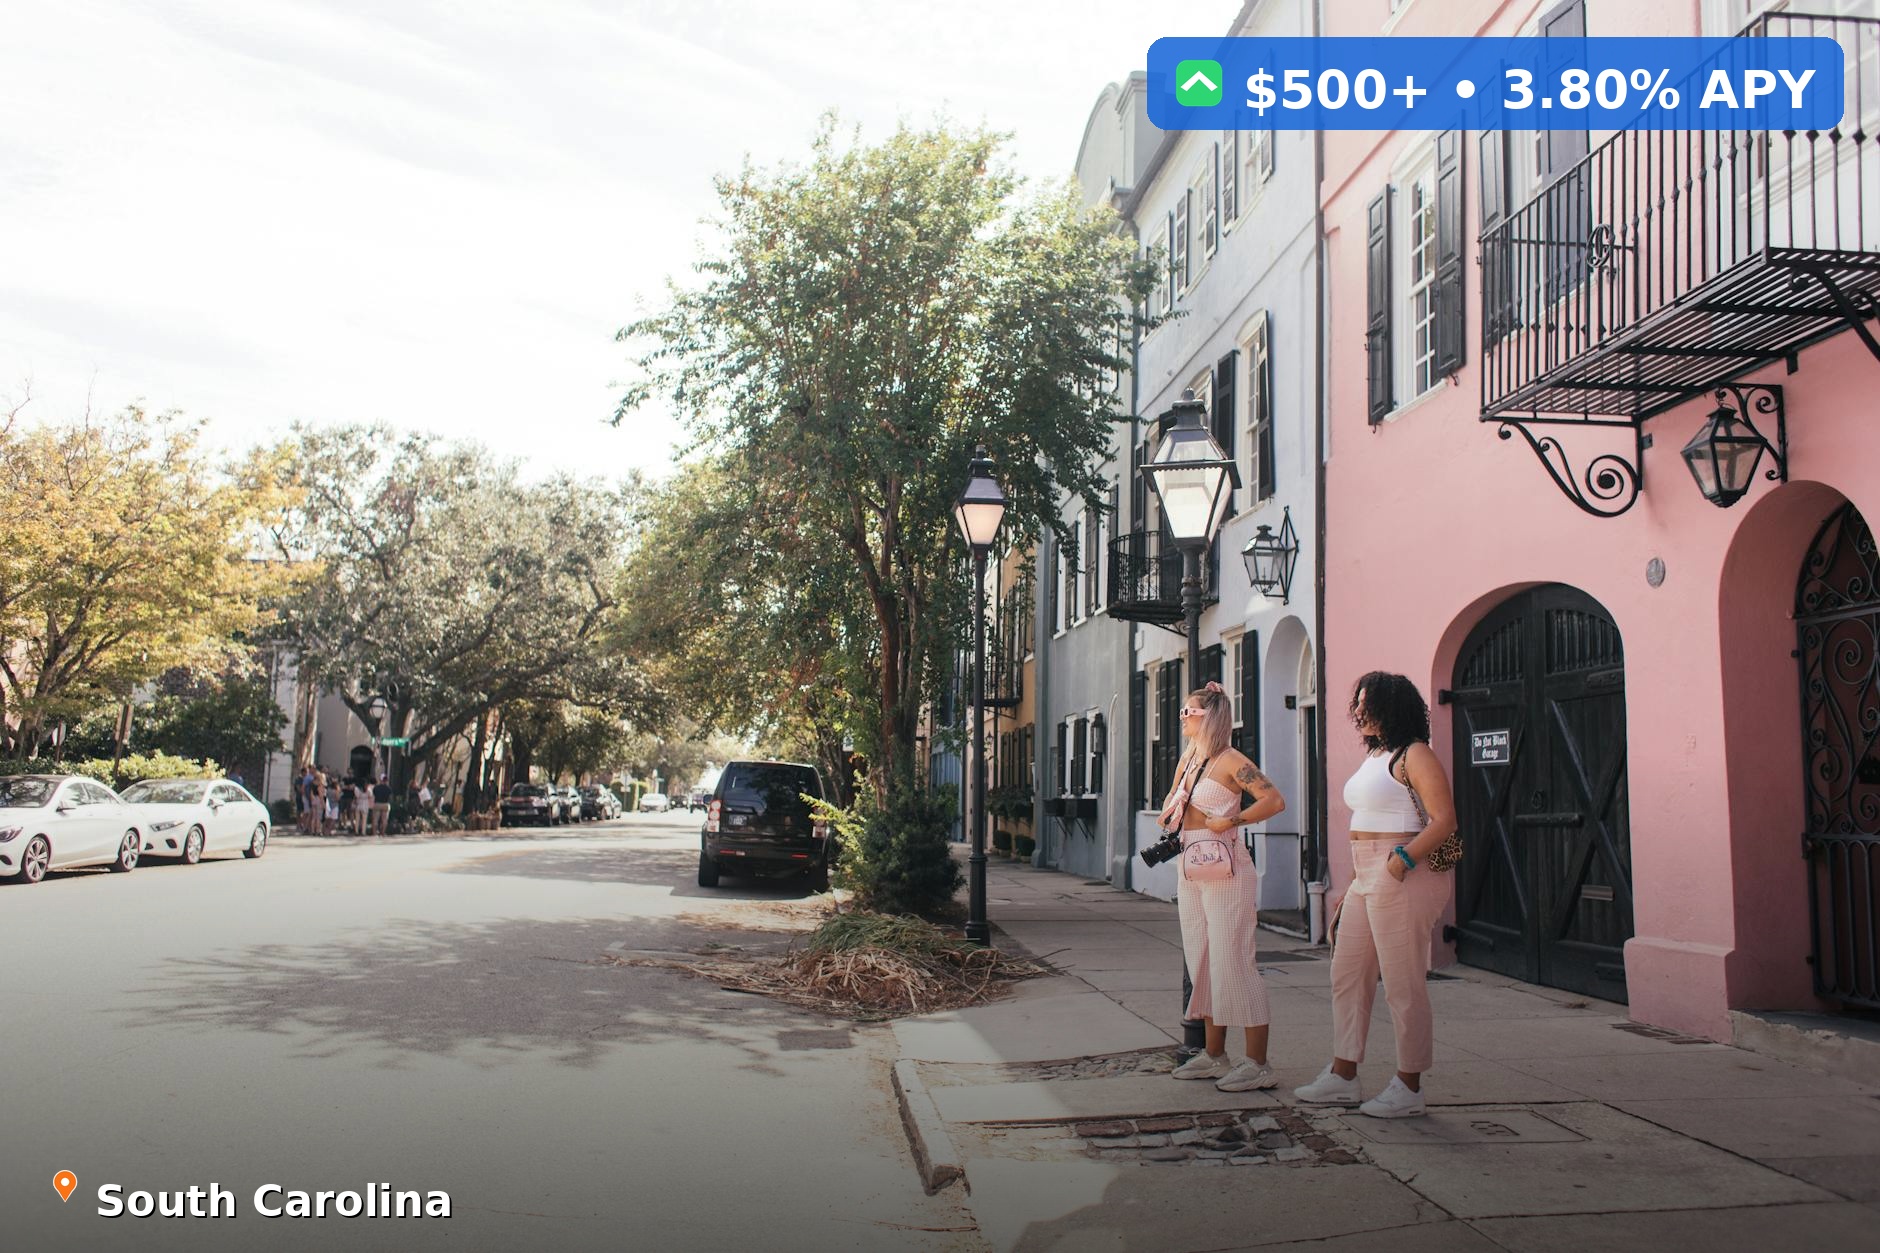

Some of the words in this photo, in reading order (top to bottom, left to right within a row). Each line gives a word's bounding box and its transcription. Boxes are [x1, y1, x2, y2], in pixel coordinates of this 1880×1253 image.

[1474, 737, 1482, 747] Do
[1482, 736, 1492, 747] Not
[1492, 735, 1507, 746] Block
[1482, 748, 1499, 760] Garage
